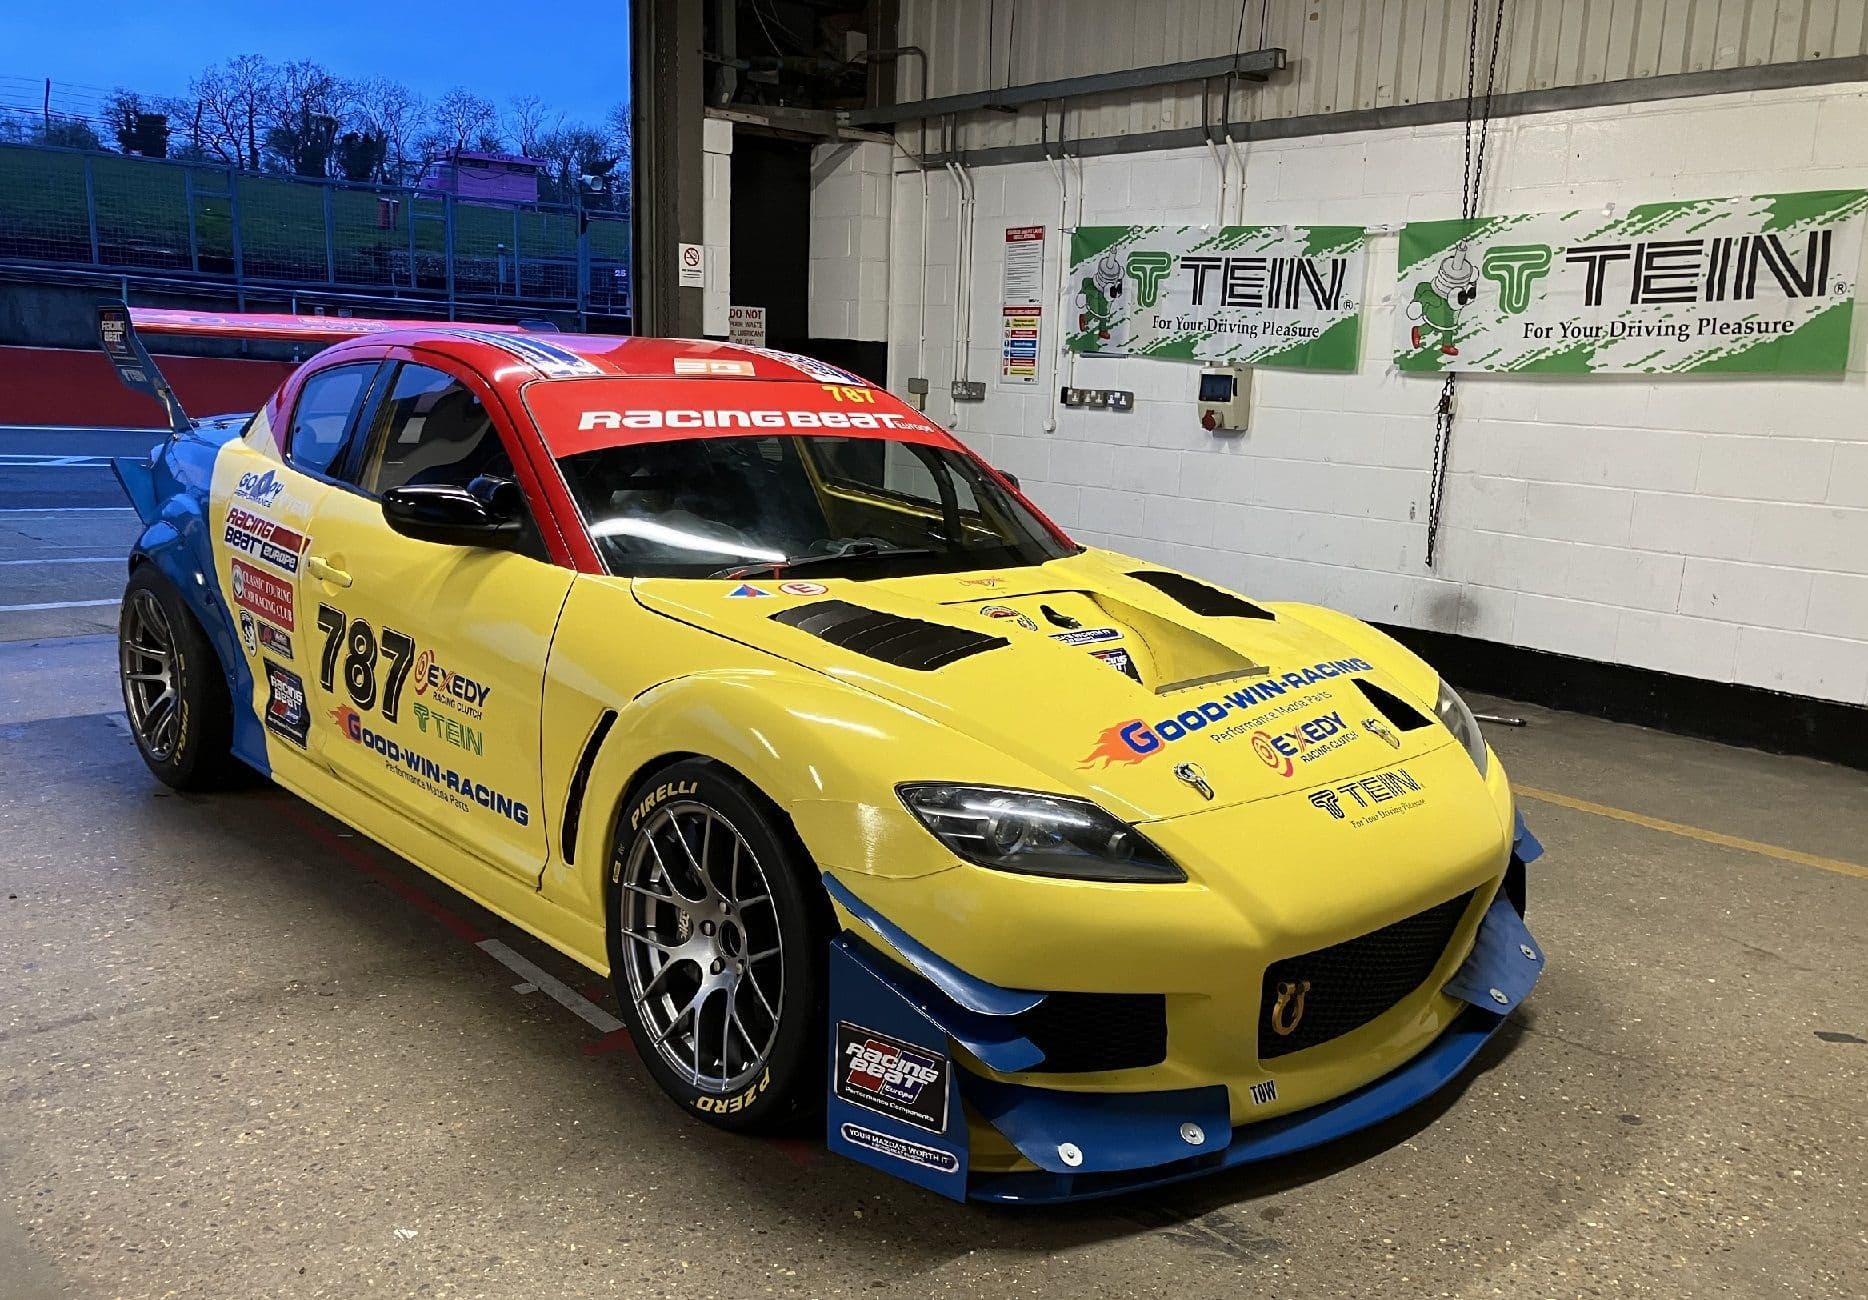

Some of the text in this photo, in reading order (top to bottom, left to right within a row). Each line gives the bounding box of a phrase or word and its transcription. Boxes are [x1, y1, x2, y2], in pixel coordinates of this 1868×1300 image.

[1180, 256, 1347, 311] TEIN
[1566, 230, 1832, 307] TEIN
[730, 308, 763, 320] DO NOT
[1152, 315, 1320, 339] For Your Driving Pleasure
[1523, 317, 1795, 342] For Your Driving Pleasure
[821, 384, 876, 404] 787
[317, 601, 416, 724] 787
[427, 663, 491, 708] EXEDY
[433, 691, 483, 721] RACING CLUTCH
[1120, 656, 1374, 754] GOOD-WIN-RACING
[430, 710, 483, 756] TEIN
[1210, 709, 1279, 744] Performance
[1304, 690, 1333, 706] Parts
[1270, 710, 1348, 756] EXEDY
[347, 712, 529, 826] GOOD-WIN-RACING
[1300, 730, 1360, 764] RACING CLUTCH
[385, 759, 426, 790] Performance
[449, 794, 470, 813] Parts
[631, 780, 698, 831] PIRELLI
[1336, 768, 1421, 808] TEIN
[696, 1066, 770, 1114] P ZERO
[845, 1085, 935, 1123] Performance Components
[1249, 1079, 1277, 1105] TOW
[849, 1128, 871, 1141] YOUR
[871, 1135, 907, 1152] MAZDA'S
[907, 1146, 939, 1161] WORTH
[941, 1156, 949, 1164] IT
